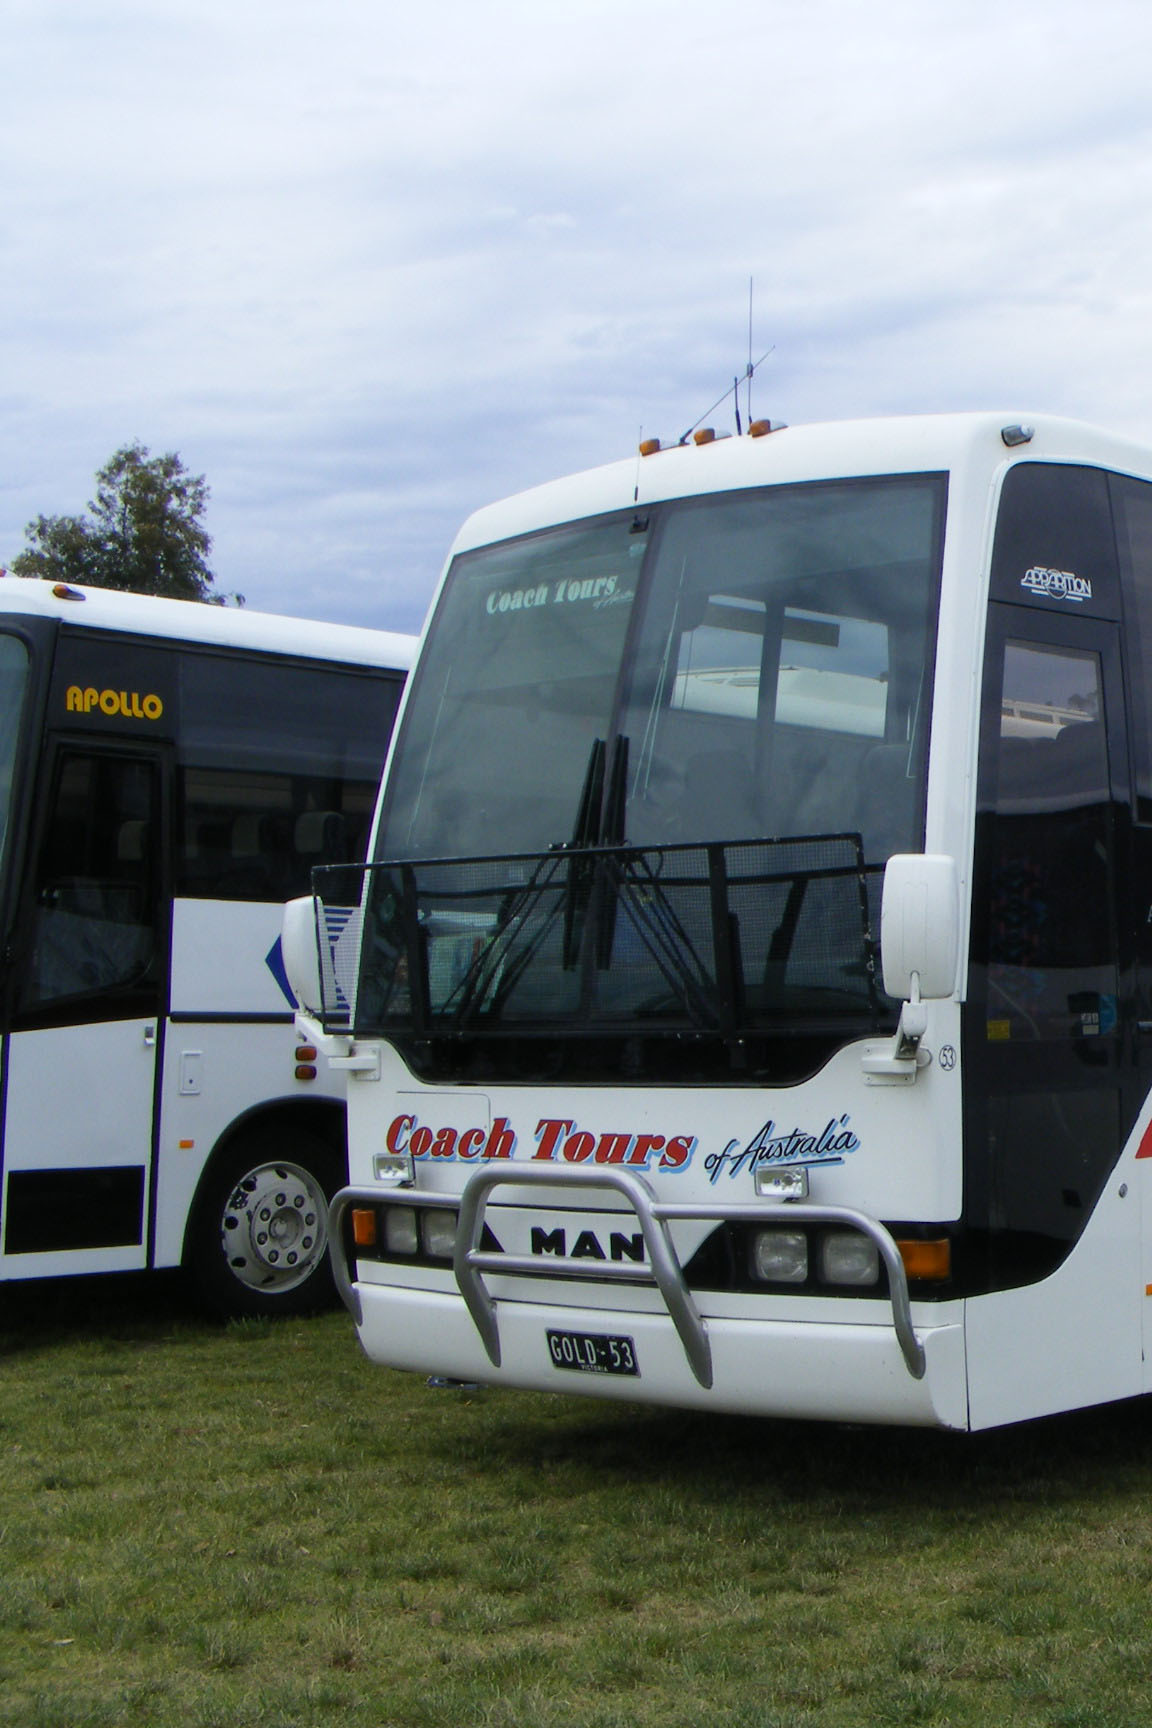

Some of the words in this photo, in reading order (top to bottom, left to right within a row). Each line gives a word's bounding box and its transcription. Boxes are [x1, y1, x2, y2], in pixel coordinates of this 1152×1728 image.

[486, 583, 548, 614] Coach
[554, 576, 618, 603] Tours
[1021, 566, 1092, 599] APPARITION
[66, 685, 163, 719] APOLLO
[941, 1047, 954, 1068] 53
[386, 1114, 518, 1163] Coach
[530, 1118, 699, 1174] Tours
[704, 1138, 740, 1185] of
[728, 1113, 861, 1179] Australia
[531, 1226, 645, 1262] MAN
